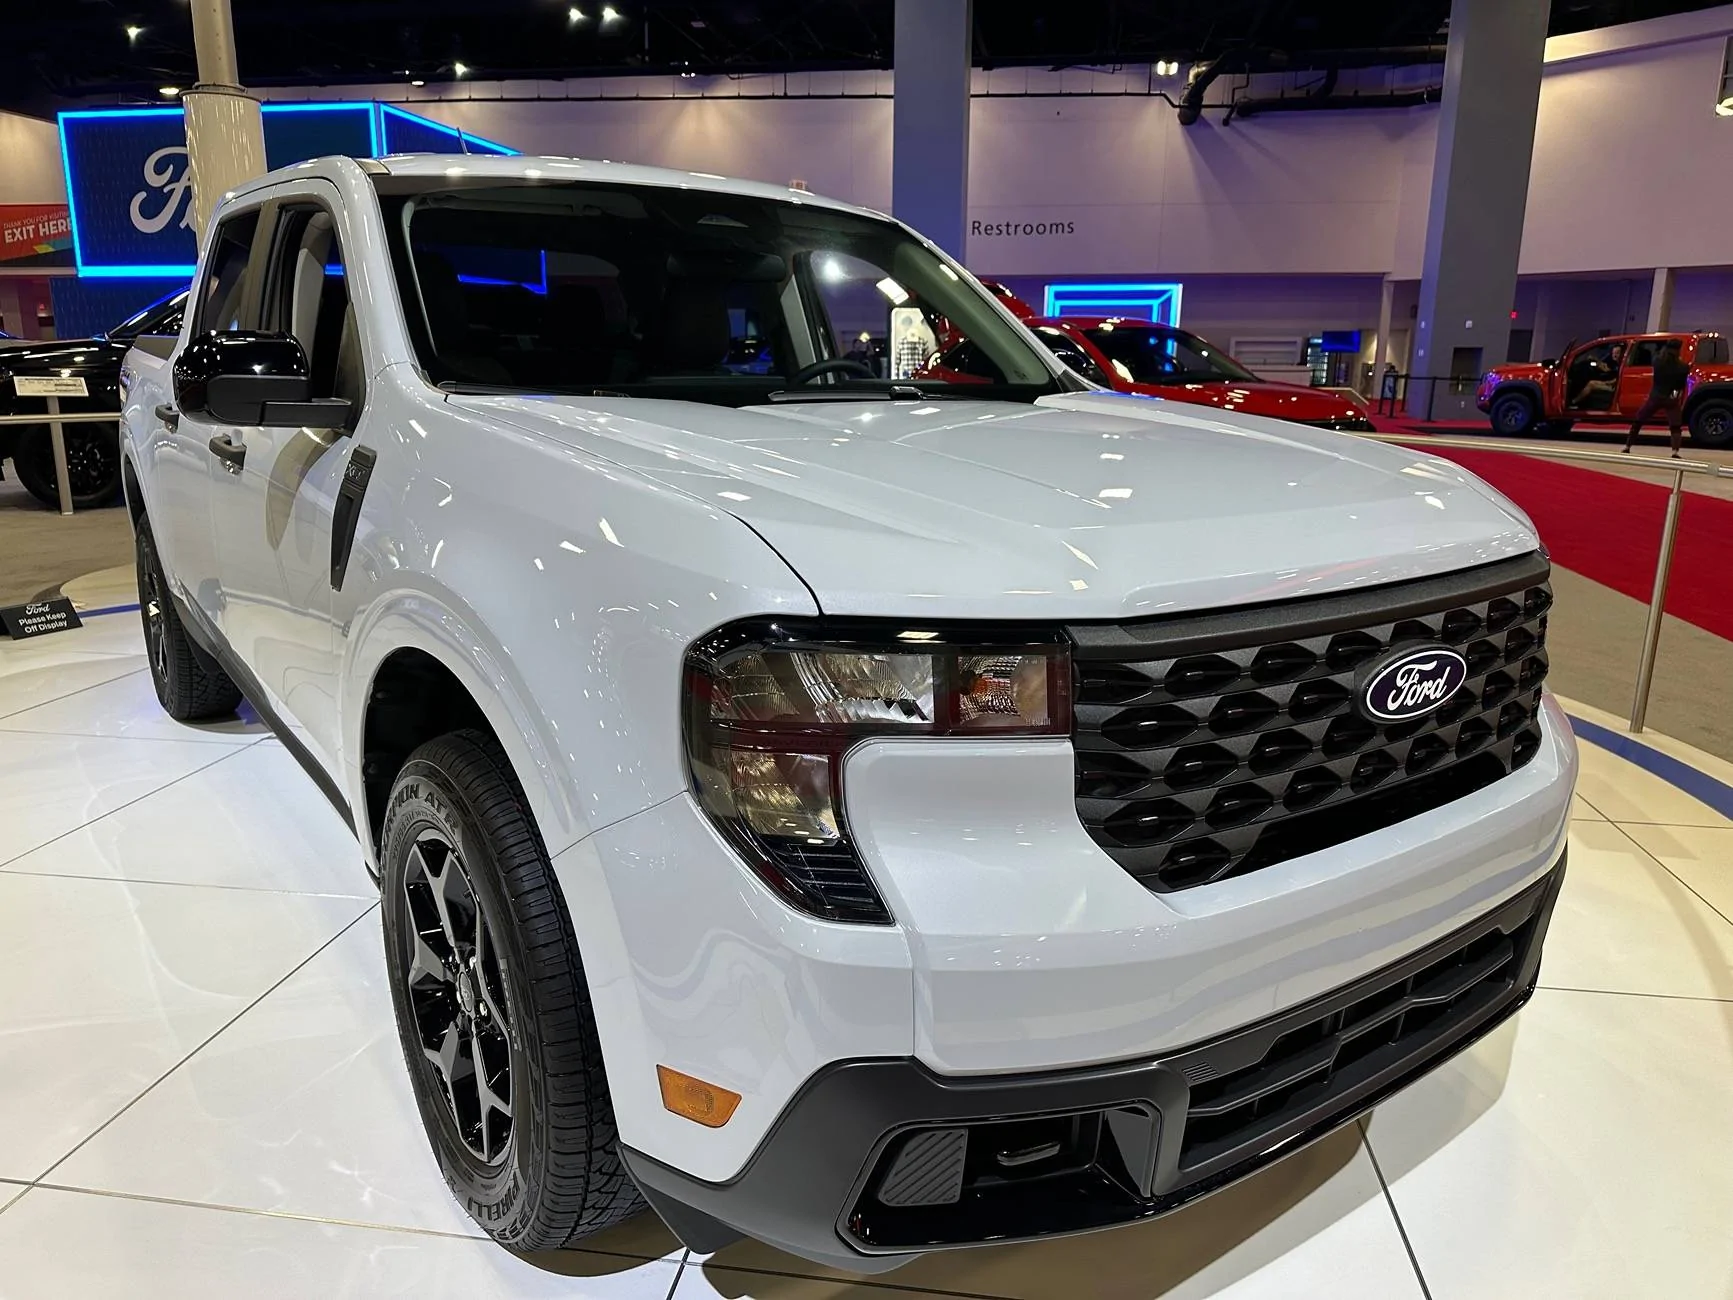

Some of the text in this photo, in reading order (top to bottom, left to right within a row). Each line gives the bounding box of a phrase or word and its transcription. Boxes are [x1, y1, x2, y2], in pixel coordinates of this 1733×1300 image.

[4, 225, 35, 244] EXIT
[971, 220, 1075, 236] Restrooms
[26, 603, 50, 615] Ford
[18, 611, 67, 626] Please Keep
[24, 620, 68, 633] Off Display
[1387, 660, 1451, 711] Ford
